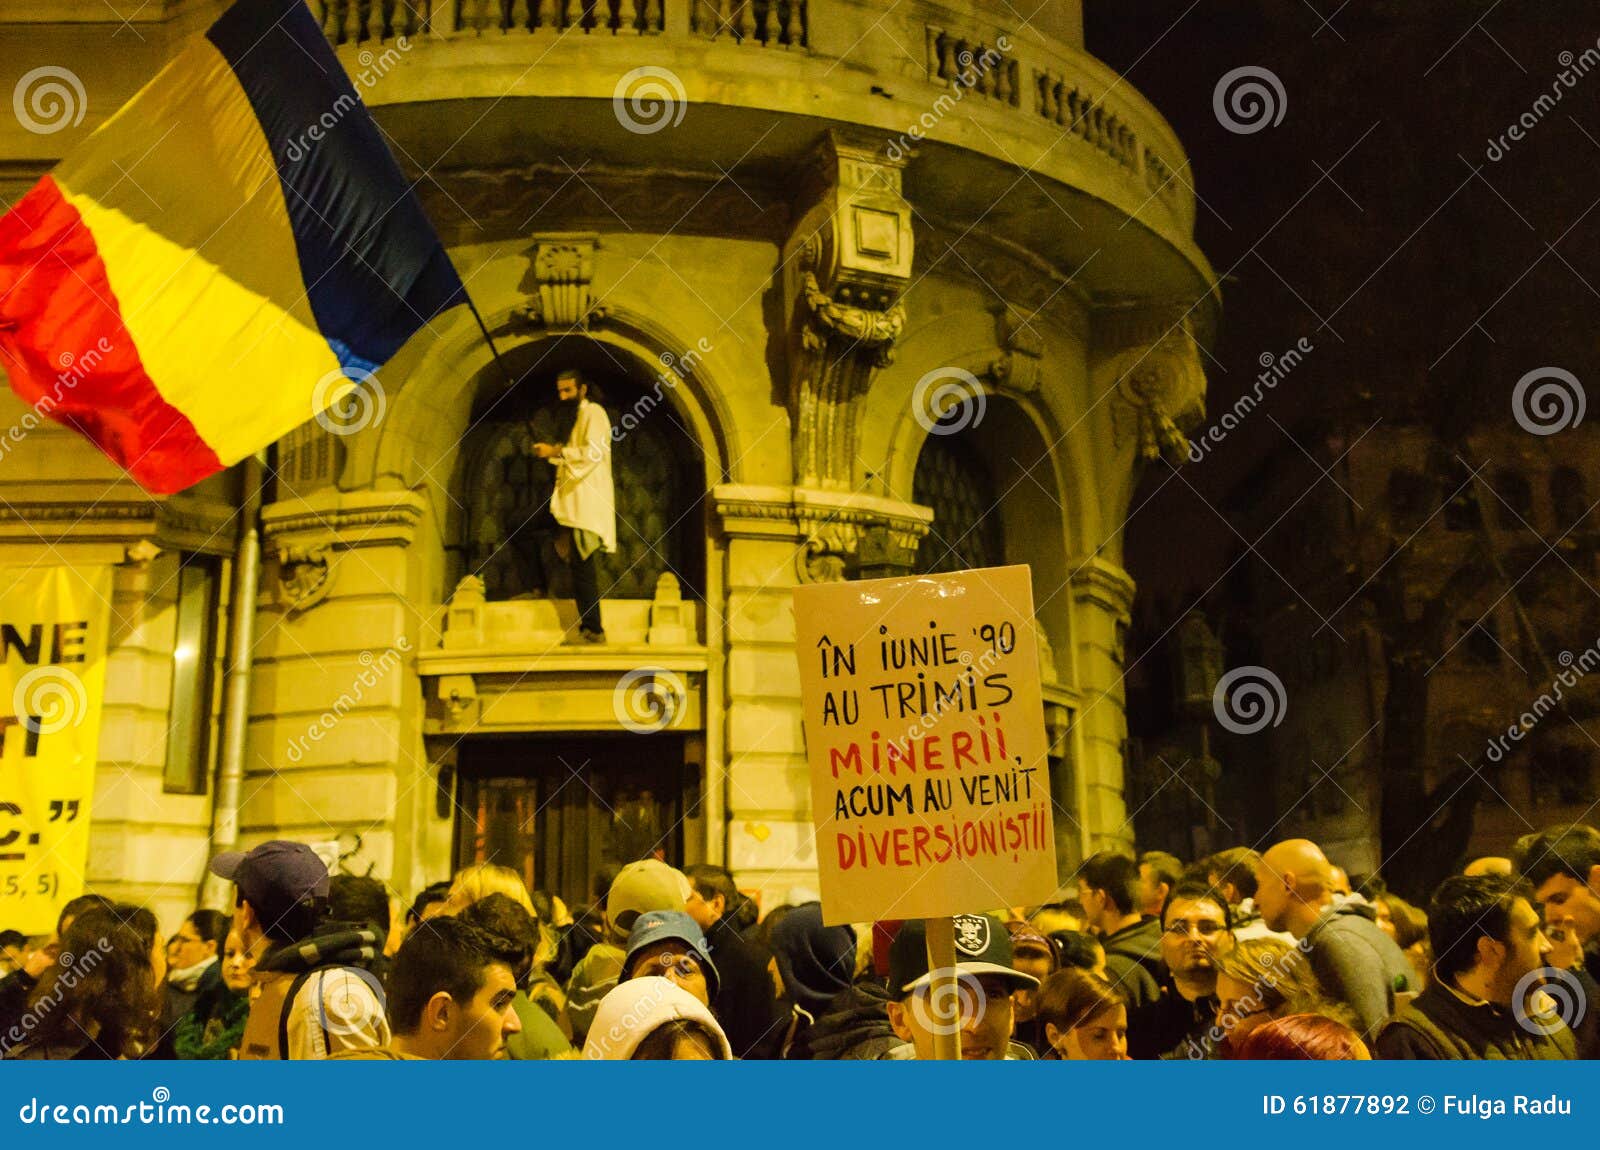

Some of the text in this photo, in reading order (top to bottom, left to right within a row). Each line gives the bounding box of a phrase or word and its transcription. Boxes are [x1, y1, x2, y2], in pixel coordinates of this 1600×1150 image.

[817, 635, 856, 678] ÎN
[823, 690, 859, 726] AU
[835, 783, 915, 821] ACUM
[923, 778, 953, 812] AU
